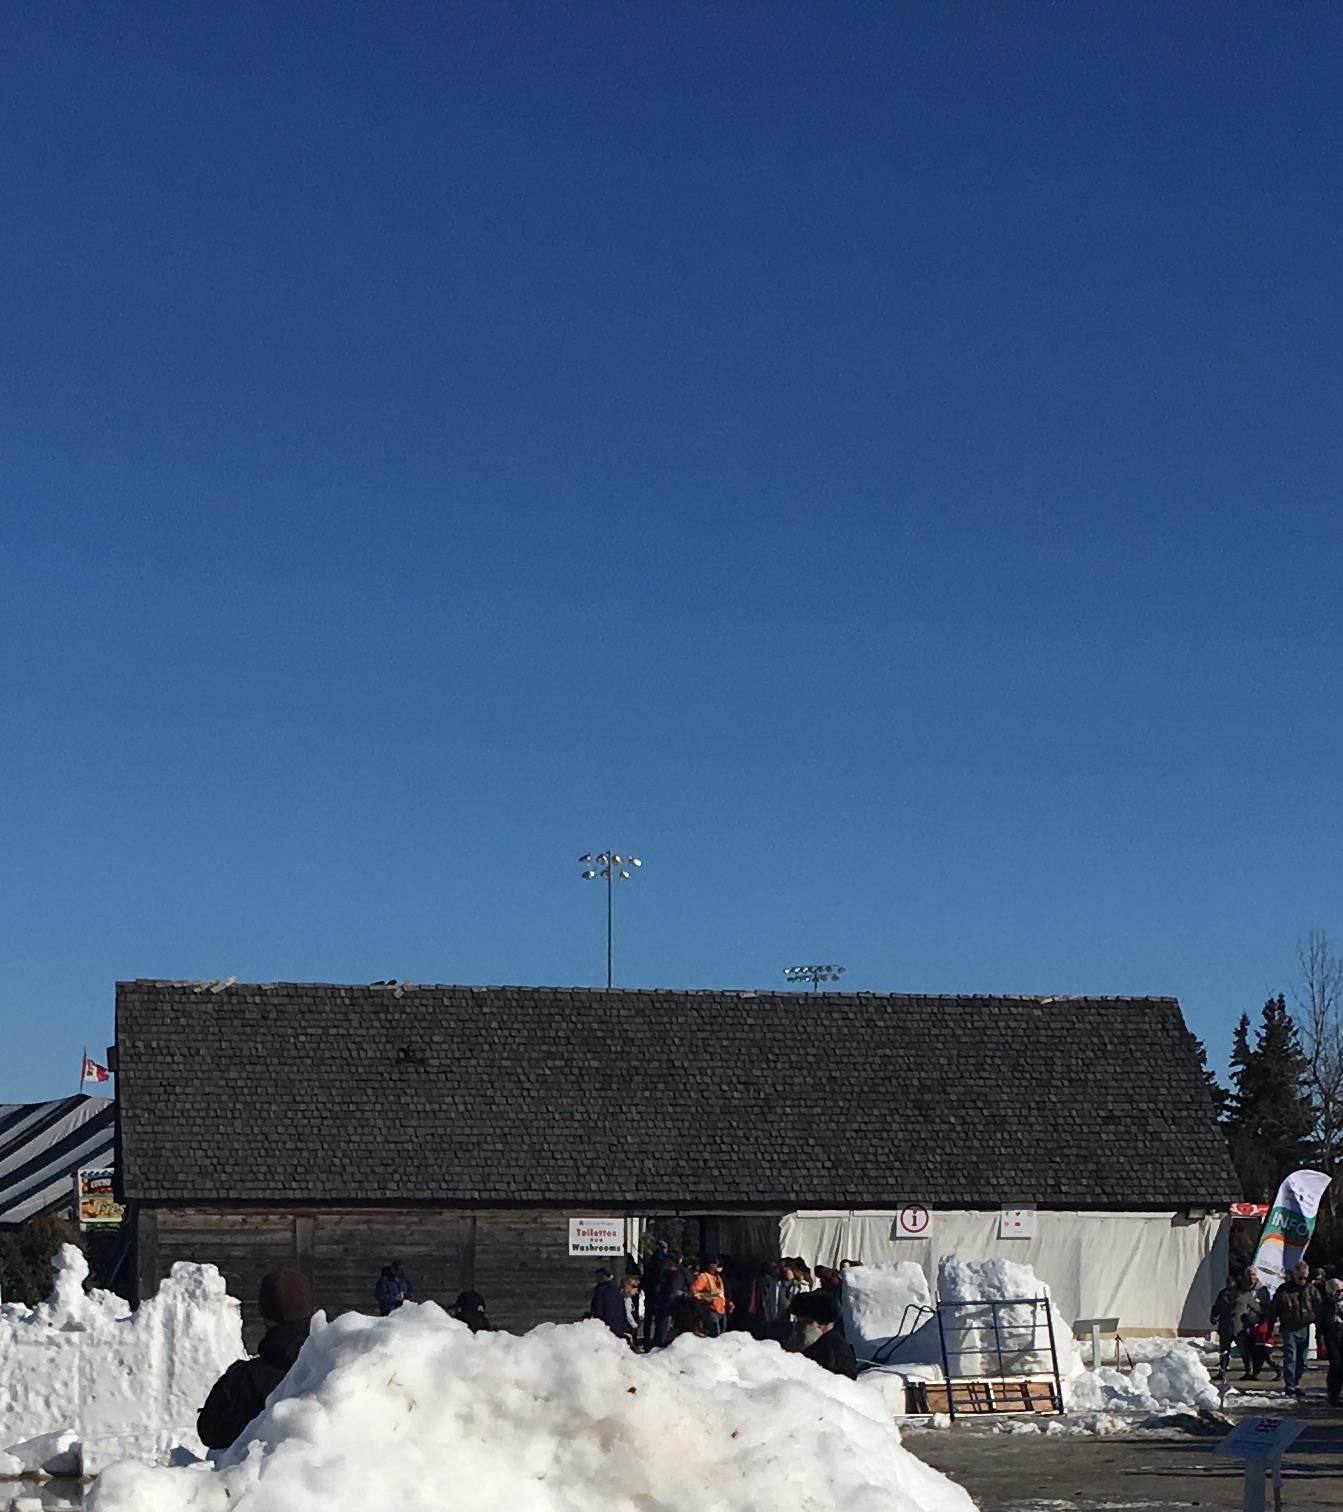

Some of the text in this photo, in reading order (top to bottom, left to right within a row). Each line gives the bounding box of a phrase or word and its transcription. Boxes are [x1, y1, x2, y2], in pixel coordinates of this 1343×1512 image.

[1271, 1211, 1308, 1236] INFO
[576, 1228, 617, 1237] Toilettes
[572, 1243, 621, 1252] Washrooms
